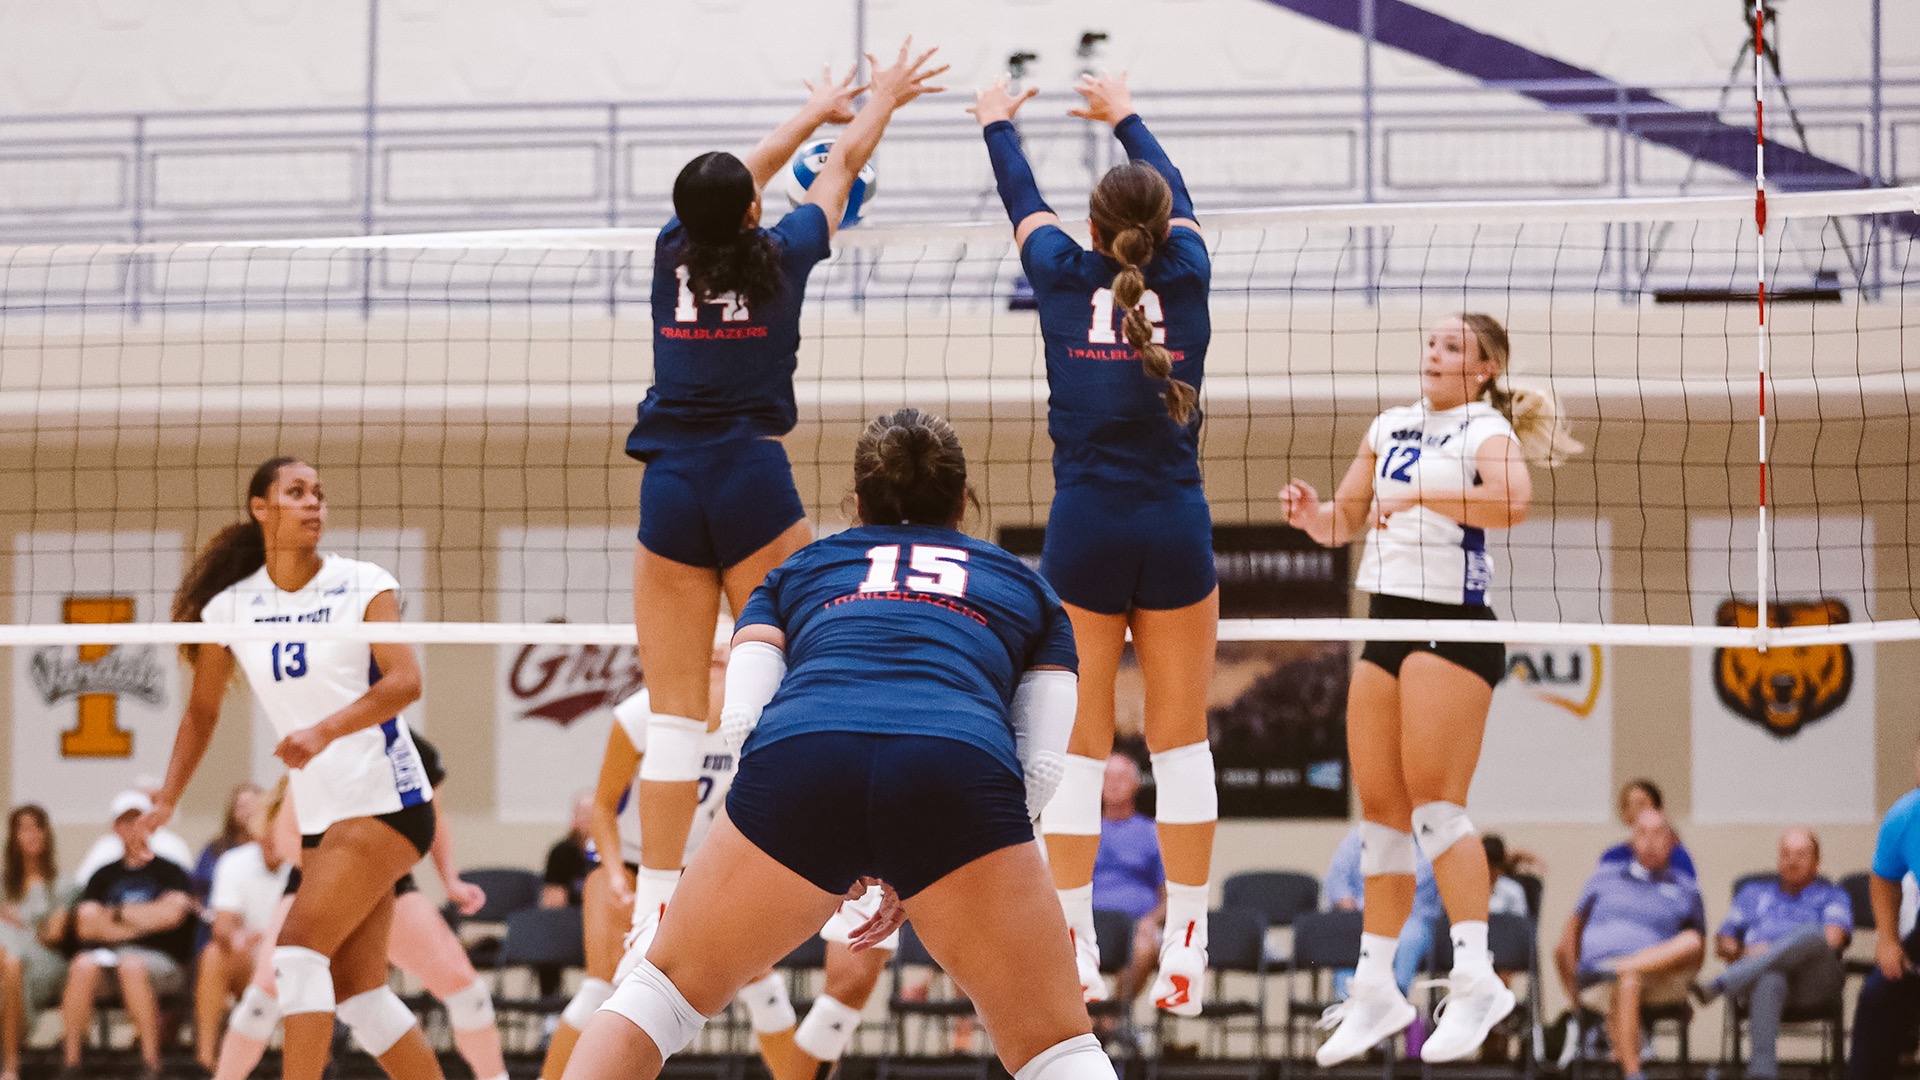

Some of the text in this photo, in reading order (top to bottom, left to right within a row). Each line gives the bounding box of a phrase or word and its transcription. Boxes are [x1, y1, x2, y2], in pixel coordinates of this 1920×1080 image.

[660, 326, 768, 339] TRAILBLAZERS
[1381, 446, 1421, 483] 12
[858, 543, 969, 598] 15
[271, 642, 308, 681] 13
